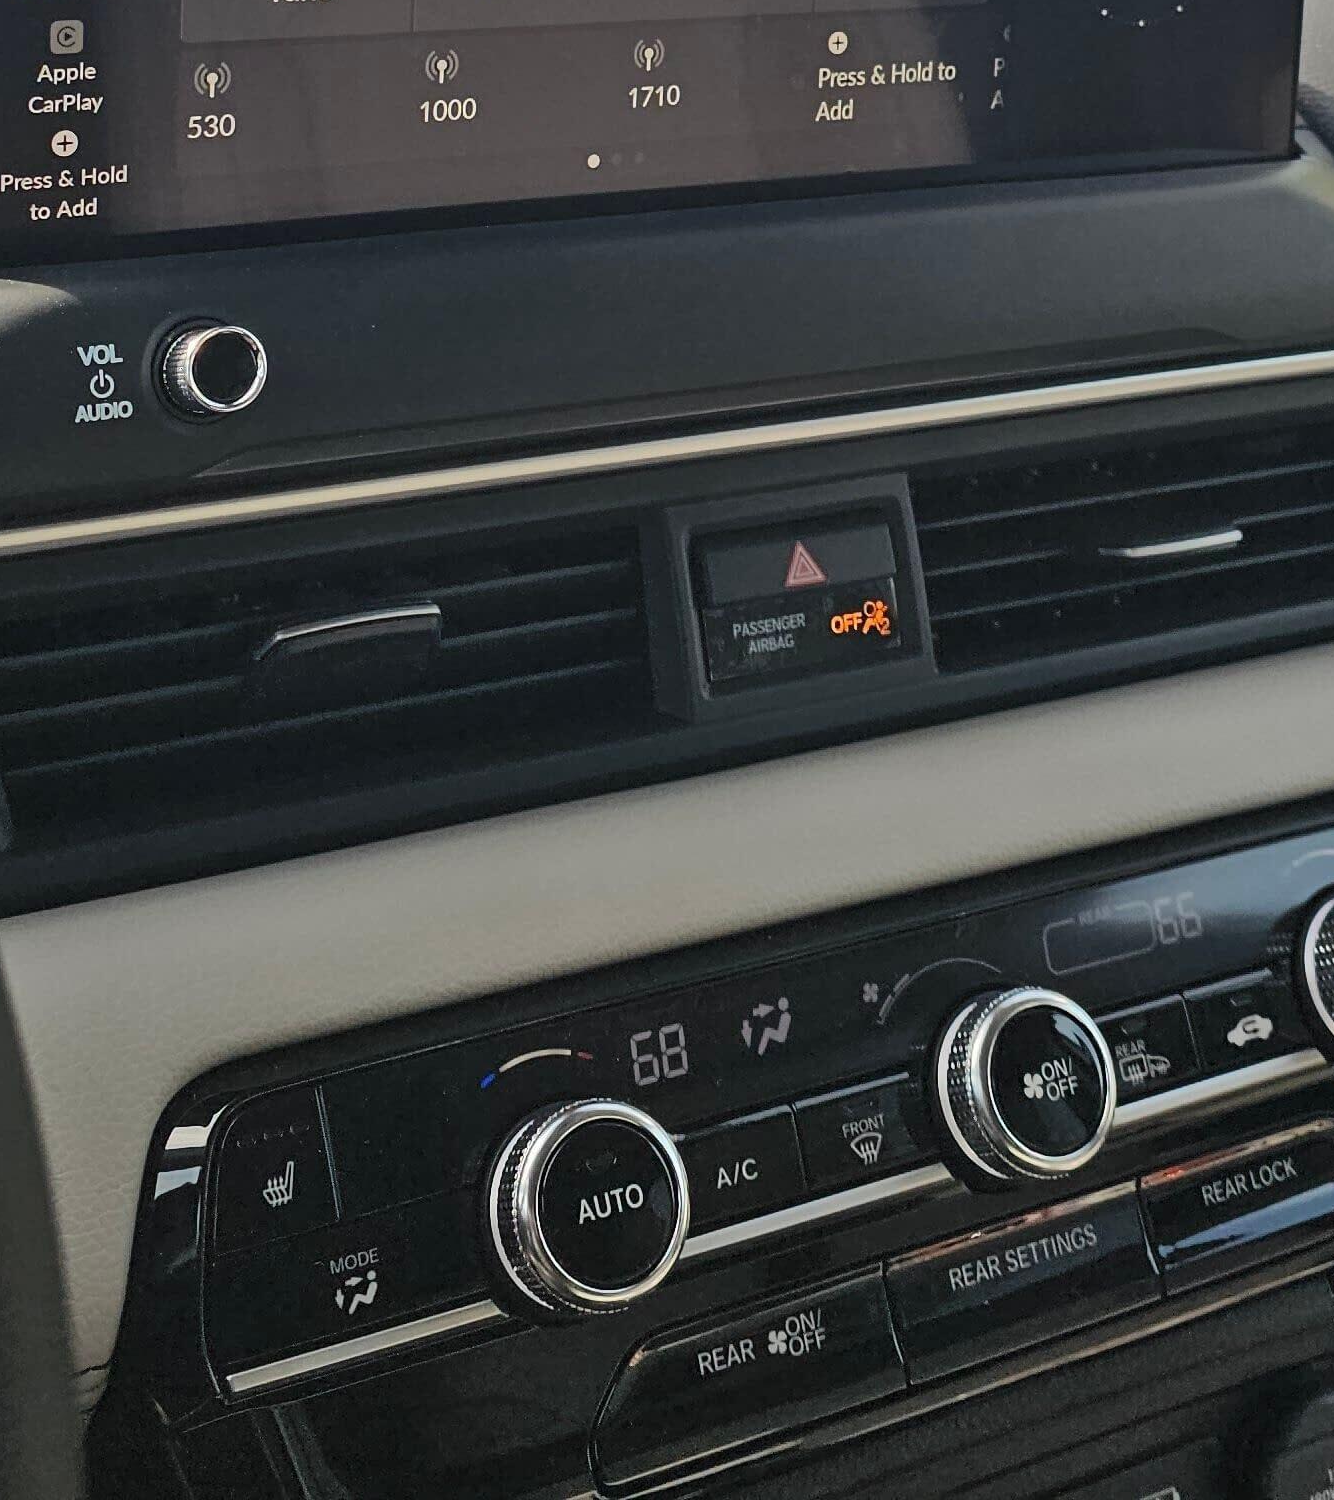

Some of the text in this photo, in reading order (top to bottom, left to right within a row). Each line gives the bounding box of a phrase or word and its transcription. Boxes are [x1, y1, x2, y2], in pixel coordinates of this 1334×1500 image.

[36, 61, 97, 85] Apple
[818, 61, 956, 89] Press & Hold to
[28, 92, 104, 114] CarPlay
[628, 84, 681, 109] 1710
[420, 97, 477, 123] 1000
[814, 98, 854, 122] Add
[187, 113, 236, 139] 530
[0, 164, 128, 193] Press & Hold
[29, 197, 98, 221] to Add
[76, 343, 124, 367] VOL
[74, 396, 134, 424] AUDIO
[732, 612, 807, 639] PASSENGER
[828, 612, 864, 634] OFF
[748, 632, 796, 655] AIRBAG
[630, 1023, 689, 1086] 68
[1115, 1039, 1146, 1057] REAR
[1046, 1076, 1079, 1100] OFF
[842, 1113, 886, 1139] FRONT
[716, 1156, 759, 1190] A/C
[1201, 1156, 1298, 1206] REAR LOCK
[578, 1182, 645, 1225] AUTO
[329, 1247, 380, 1275] MODE
[948, 1222, 1099, 1293] REAR SETTINGS
[789, 1328, 827, 1359] OFF
[697, 1338, 756, 1377] REAR
